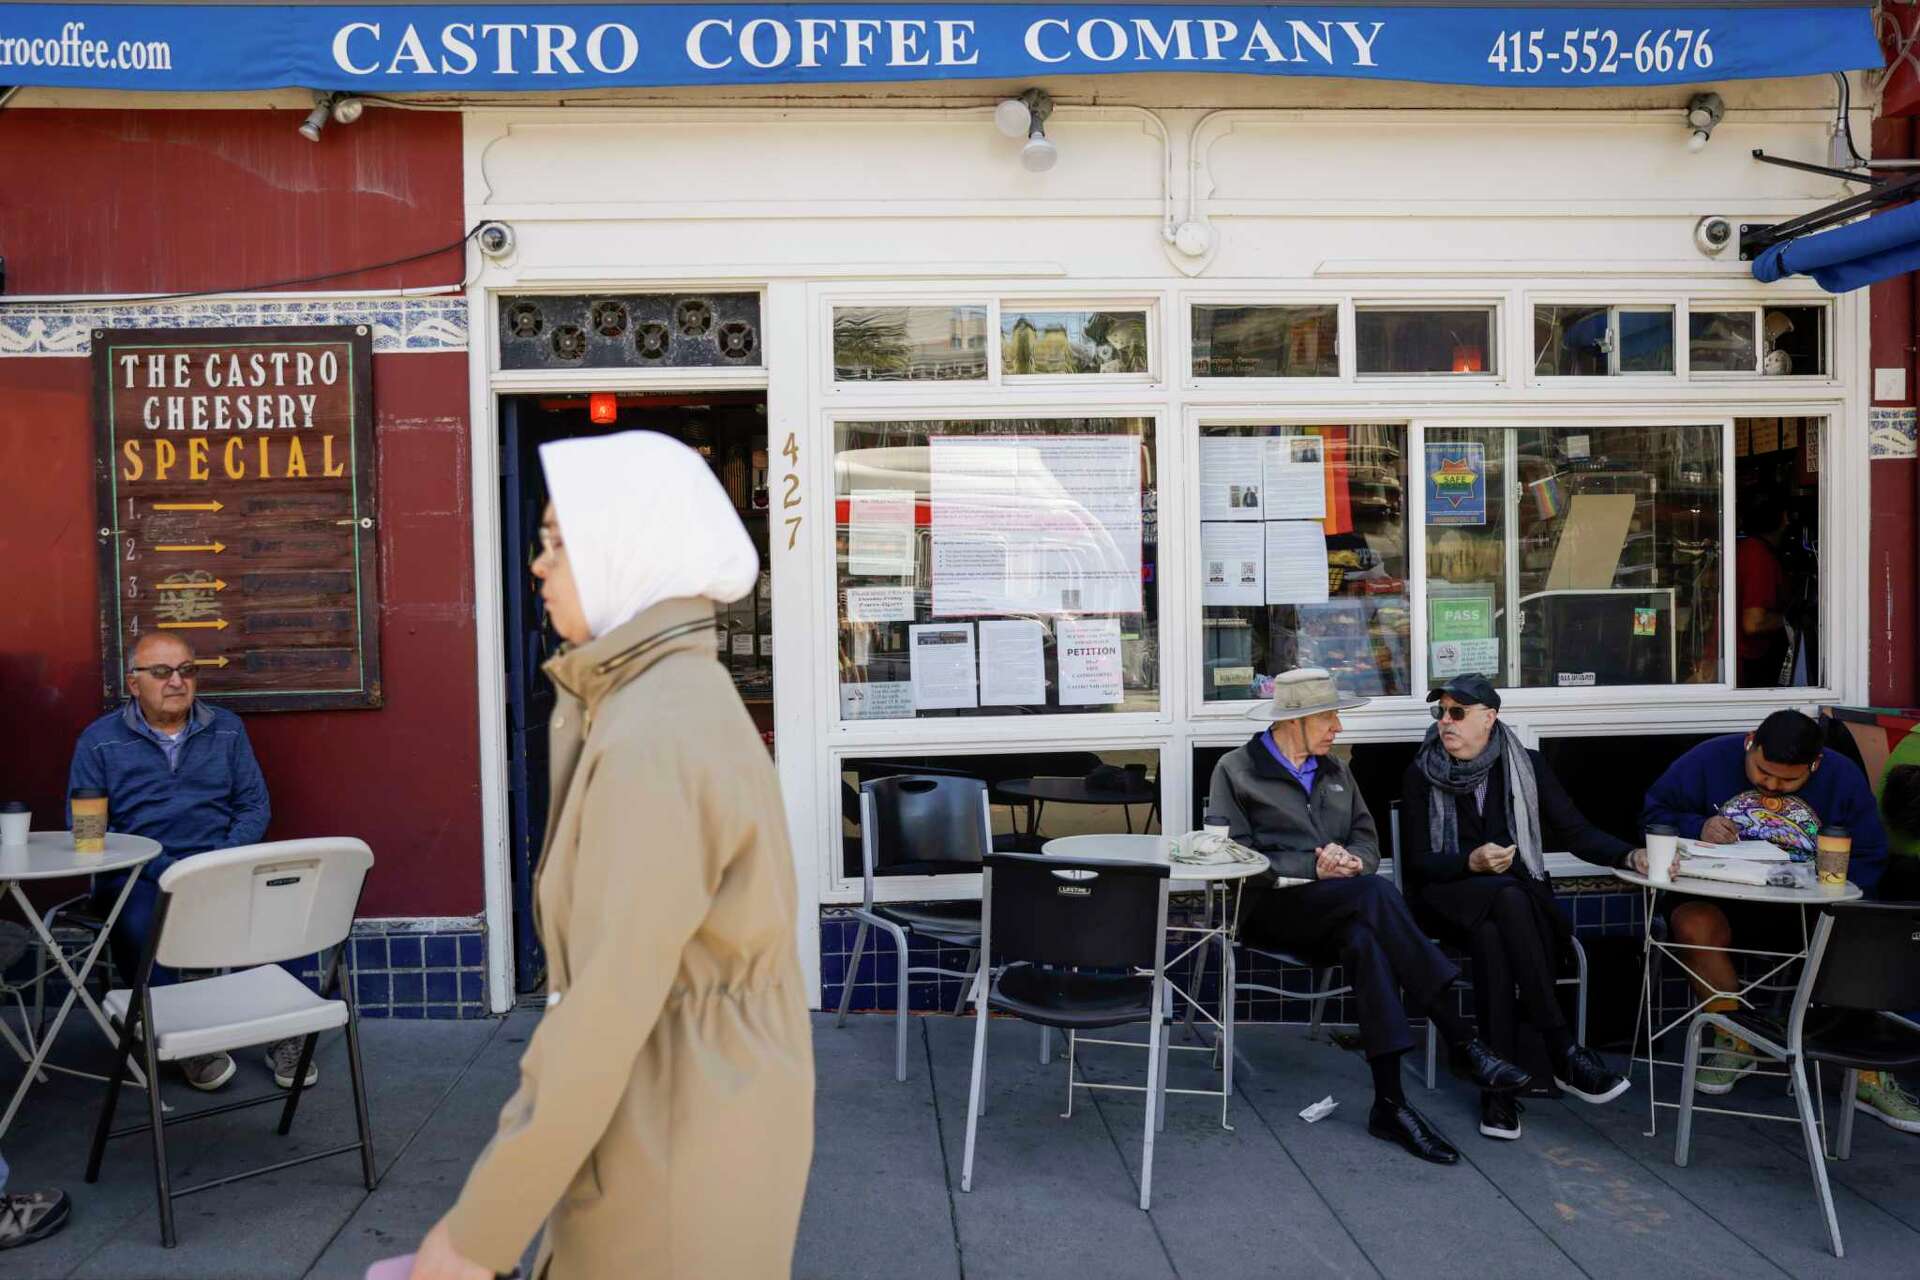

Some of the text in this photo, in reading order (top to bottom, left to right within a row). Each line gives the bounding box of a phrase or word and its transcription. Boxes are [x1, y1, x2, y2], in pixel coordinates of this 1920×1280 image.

[332, 18, 1385, 75] CASTRO COFFEE COMPANY
[1487, 28, 1714, 74] 415-552-6676
[120, 350, 338, 389] THE CASTRO
[143, 394, 317, 431] CHEESERY
[123, 434, 344, 481] SPECIAL
[1443, 475, 1468, 484] SAFE
[1445, 609, 1481, 621] PASS
[1066, 647, 1117, 657] PETITION
